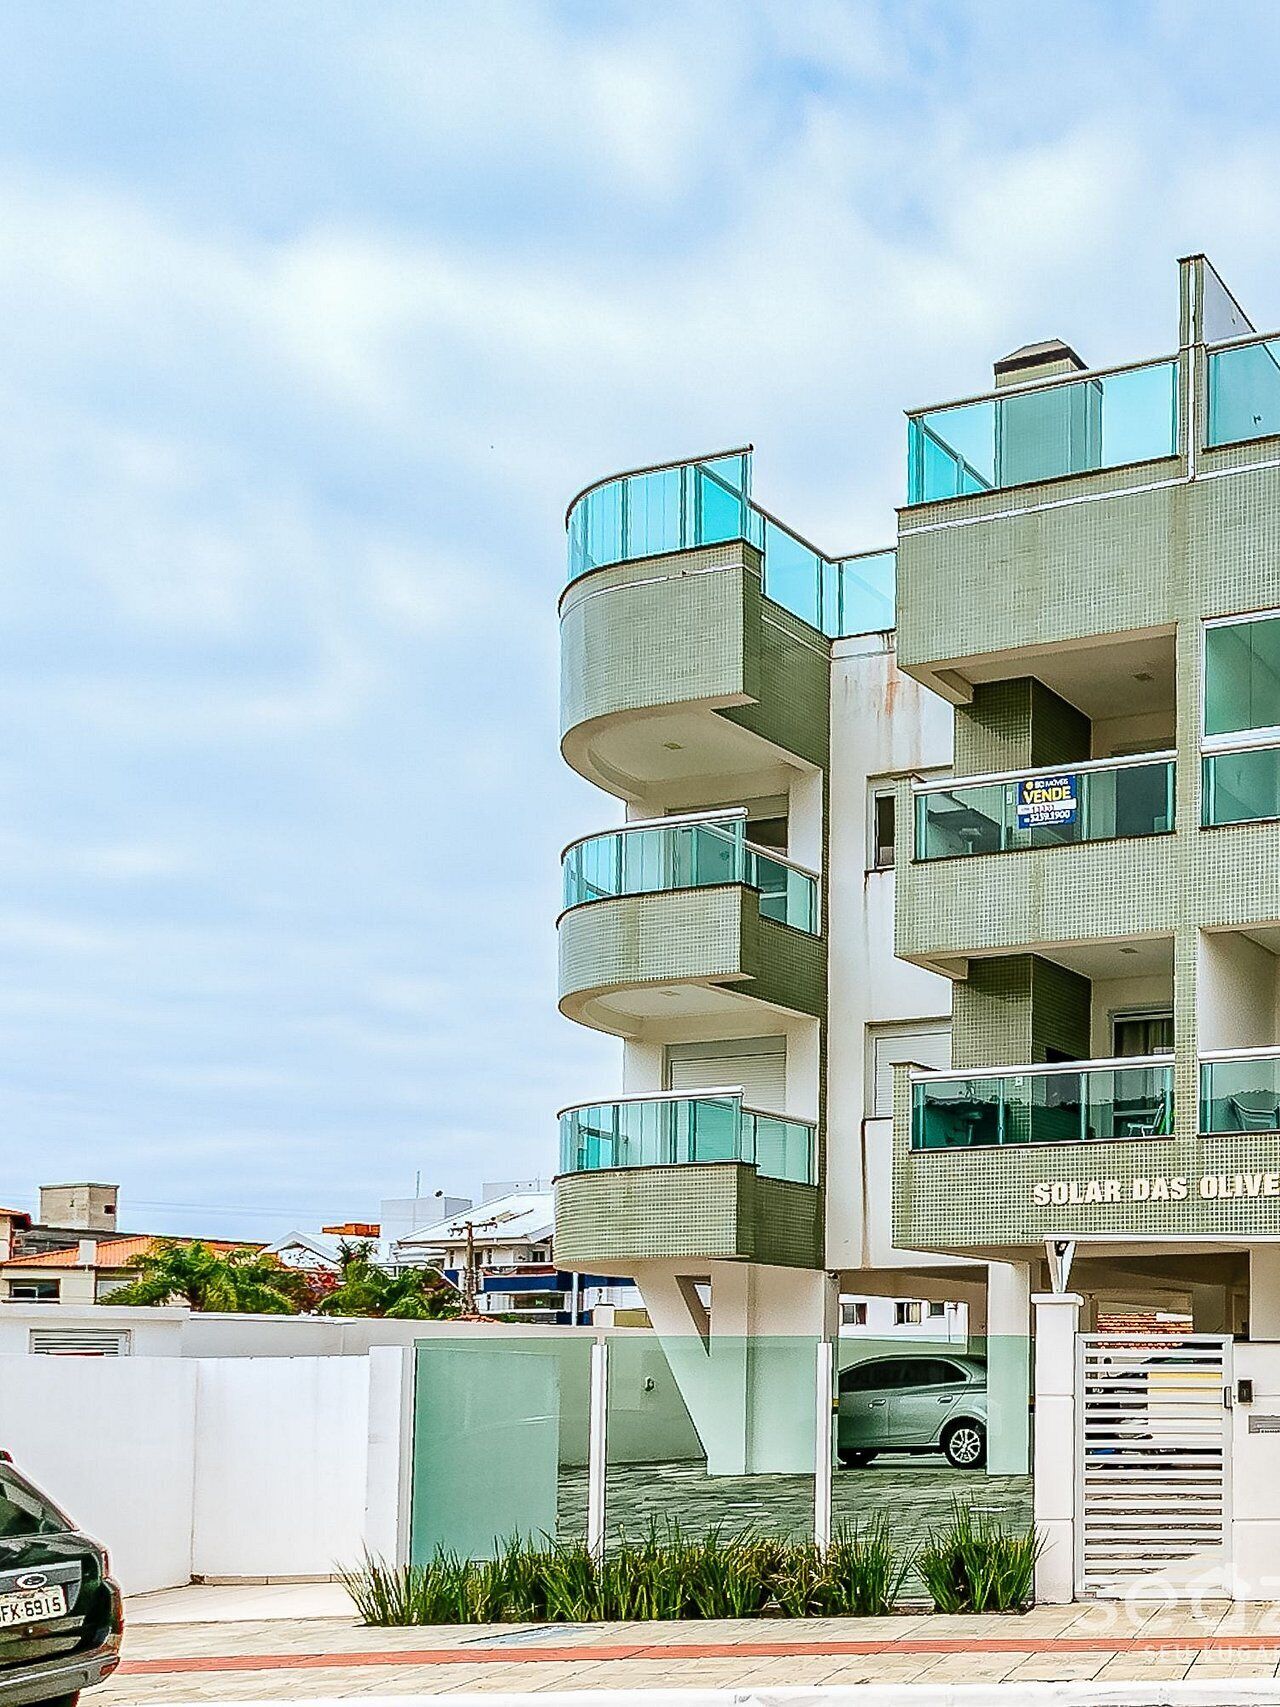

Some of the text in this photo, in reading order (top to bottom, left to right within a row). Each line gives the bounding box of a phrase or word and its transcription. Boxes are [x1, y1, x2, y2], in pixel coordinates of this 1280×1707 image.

[1023, 786, 1072, 804] VENDE
[1033, 1181, 1122, 1206] SOLAR
[1131, 1177, 1189, 1202] DAS
